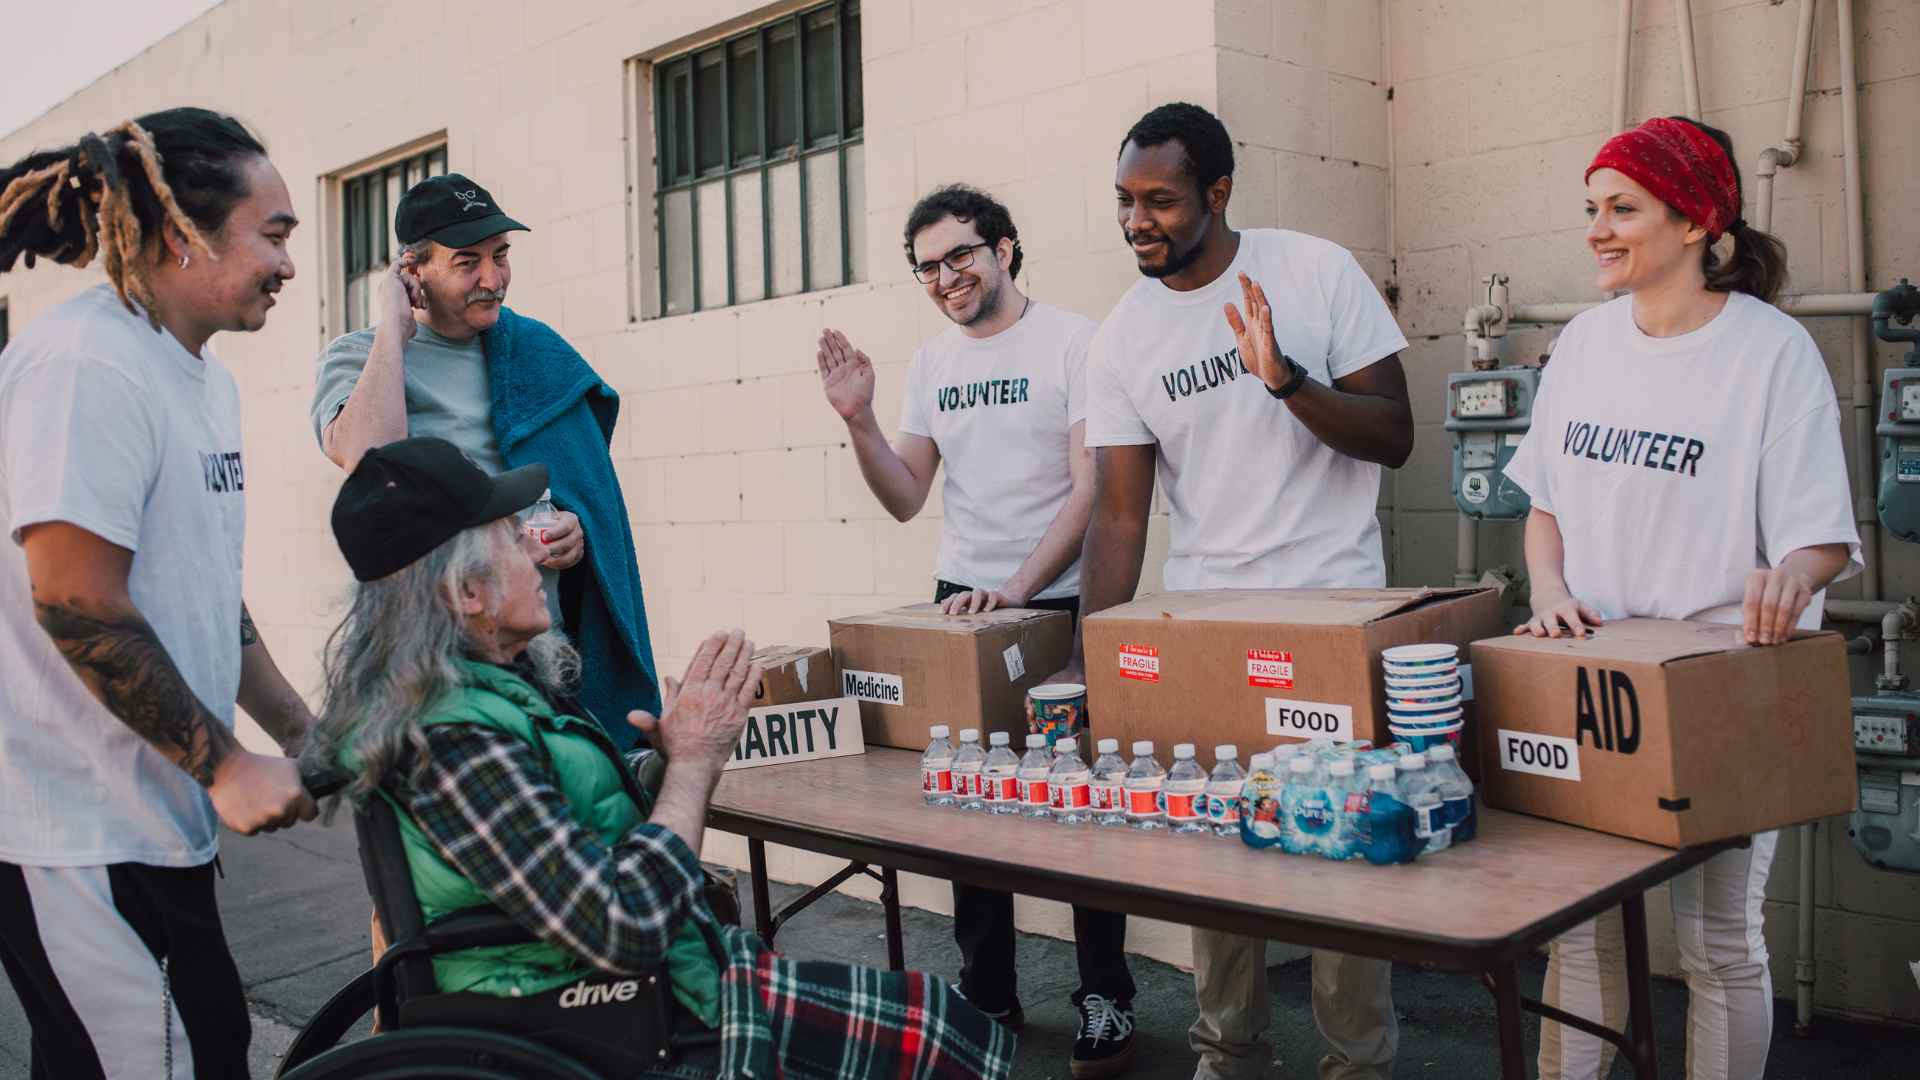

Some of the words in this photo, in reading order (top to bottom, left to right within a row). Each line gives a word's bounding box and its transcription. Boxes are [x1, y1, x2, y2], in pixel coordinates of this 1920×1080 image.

[938, 377, 1029, 412] VOLUNTEER
[1563, 421, 1705, 477] VOLUNTEER
[1123, 656, 1158, 671] FRAGILE
[1251, 663, 1289, 677] FRAGILE
[845, 672, 900, 701] Medicine
[1279, 708, 1339, 733] FOOD
[1576, 666, 1641, 755] AID
[1507, 737, 1568, 770] FOOD
[559, 980, 639, 1009] drive
